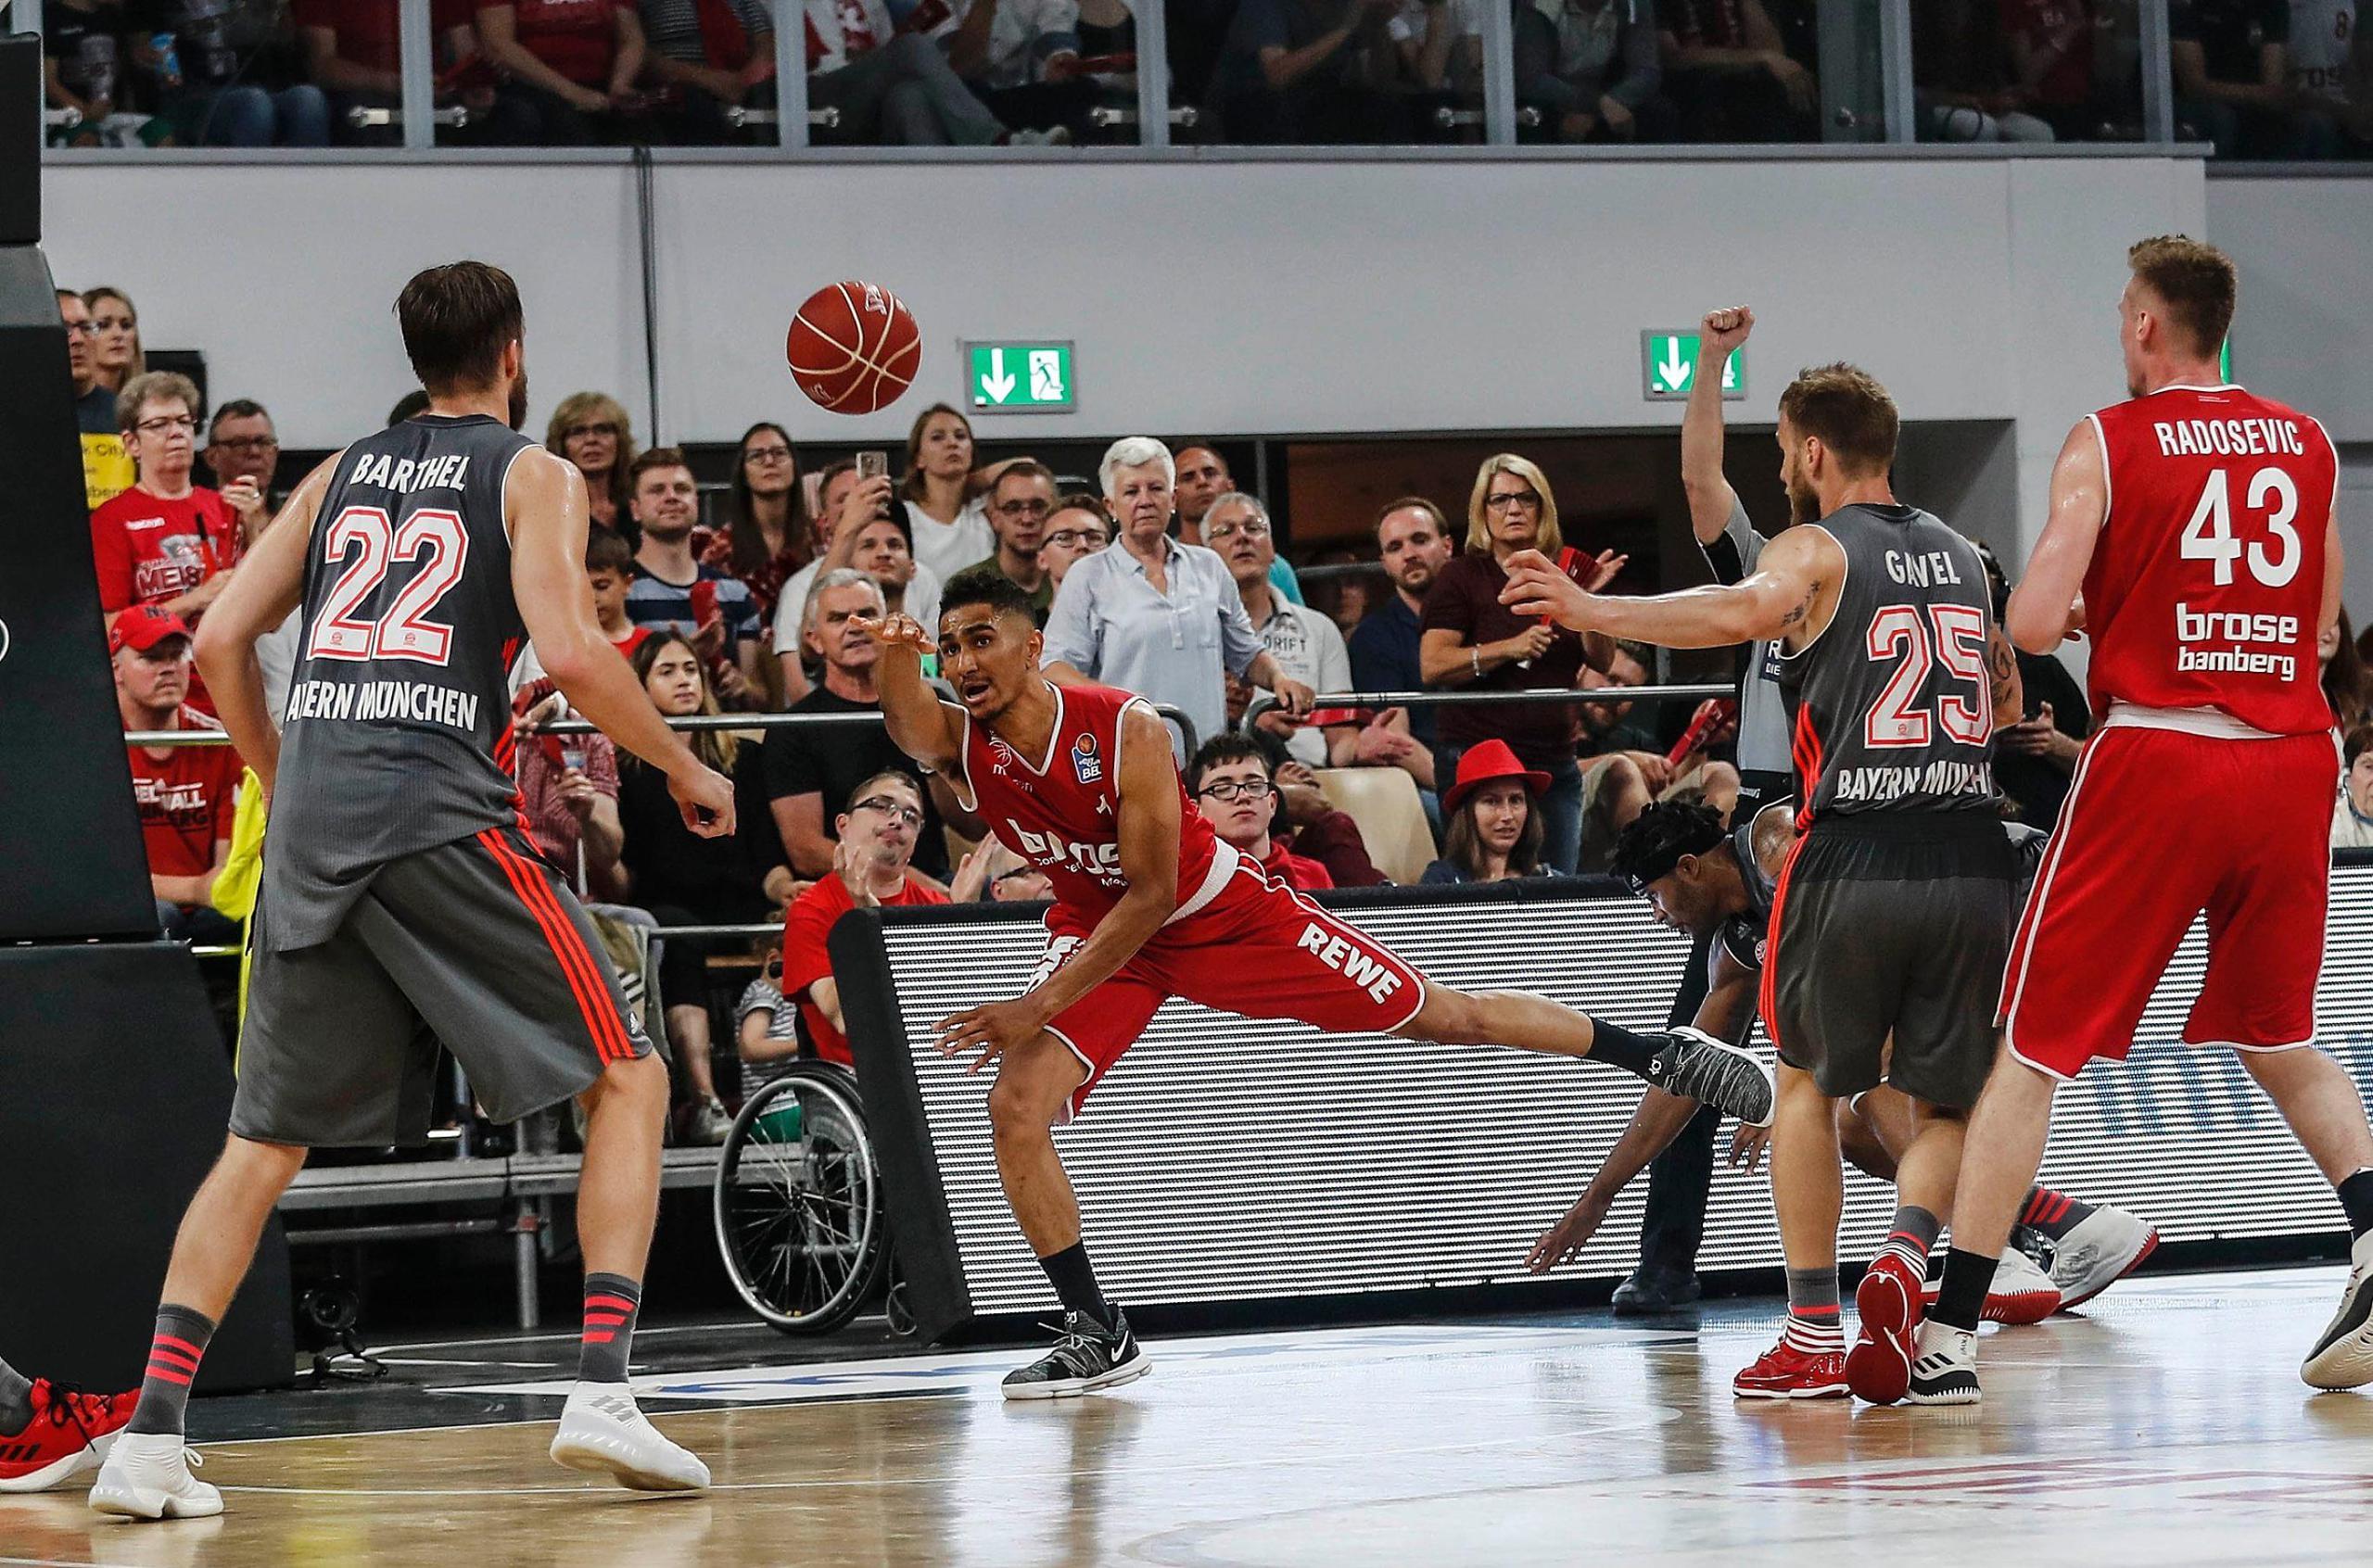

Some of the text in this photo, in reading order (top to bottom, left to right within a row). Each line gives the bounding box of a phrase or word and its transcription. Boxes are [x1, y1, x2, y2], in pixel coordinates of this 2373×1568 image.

[2153, 417, 2304, 457] RADOSEVIC
[349, 452, 471, 495] BARTHEL
[2180, 466, 2303, 588] 43
[306, 505, 471, 667] 22
[1884, 550, 1962, 589] GAVEL
[2176, 602, 2299, 644] brose
[1864, 603, 1993, 749] 25
[2177, 645, 2296, 682] bamberg
[1834, 765, 1921, 802] BAYERN
[1297, 921, 1402, 1005] REWE
